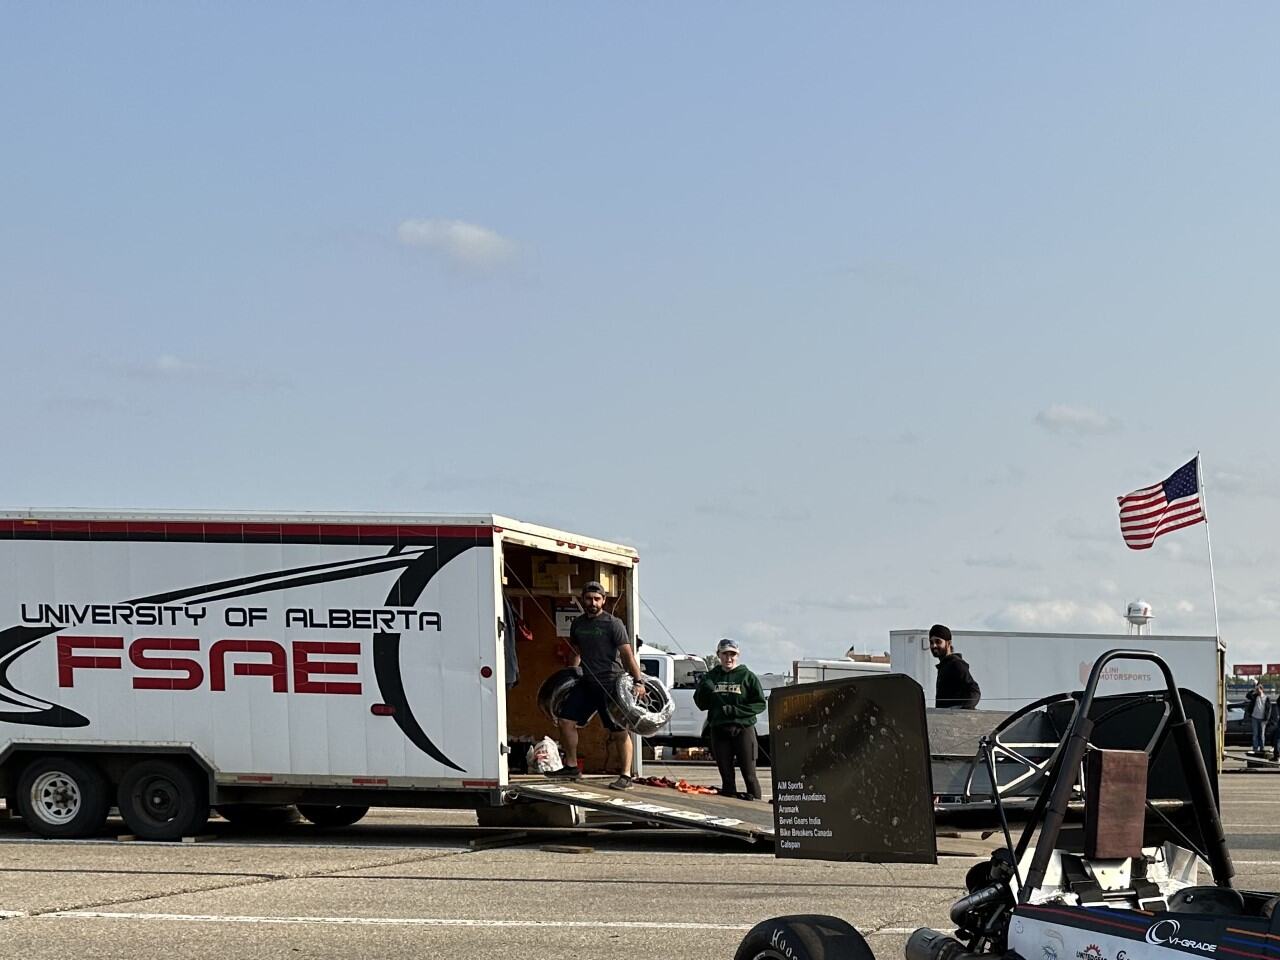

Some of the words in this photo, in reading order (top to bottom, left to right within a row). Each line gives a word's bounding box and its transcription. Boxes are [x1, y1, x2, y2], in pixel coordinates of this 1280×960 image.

[21, 603, 207, 626] UNIVERSITY
[225, 608, 268, 628] OF
[286, 609, 443, 632] ALBERTA
[57, 636, 362, 695] FSAE
[787, 781, 804, 791] Sports
[793, 816, 809, 825] Gears
[808, 816, 821, 825] India
[813, 829, 833, 838] Canada
[1168, 936, 1217, 953] VI-GRADE
